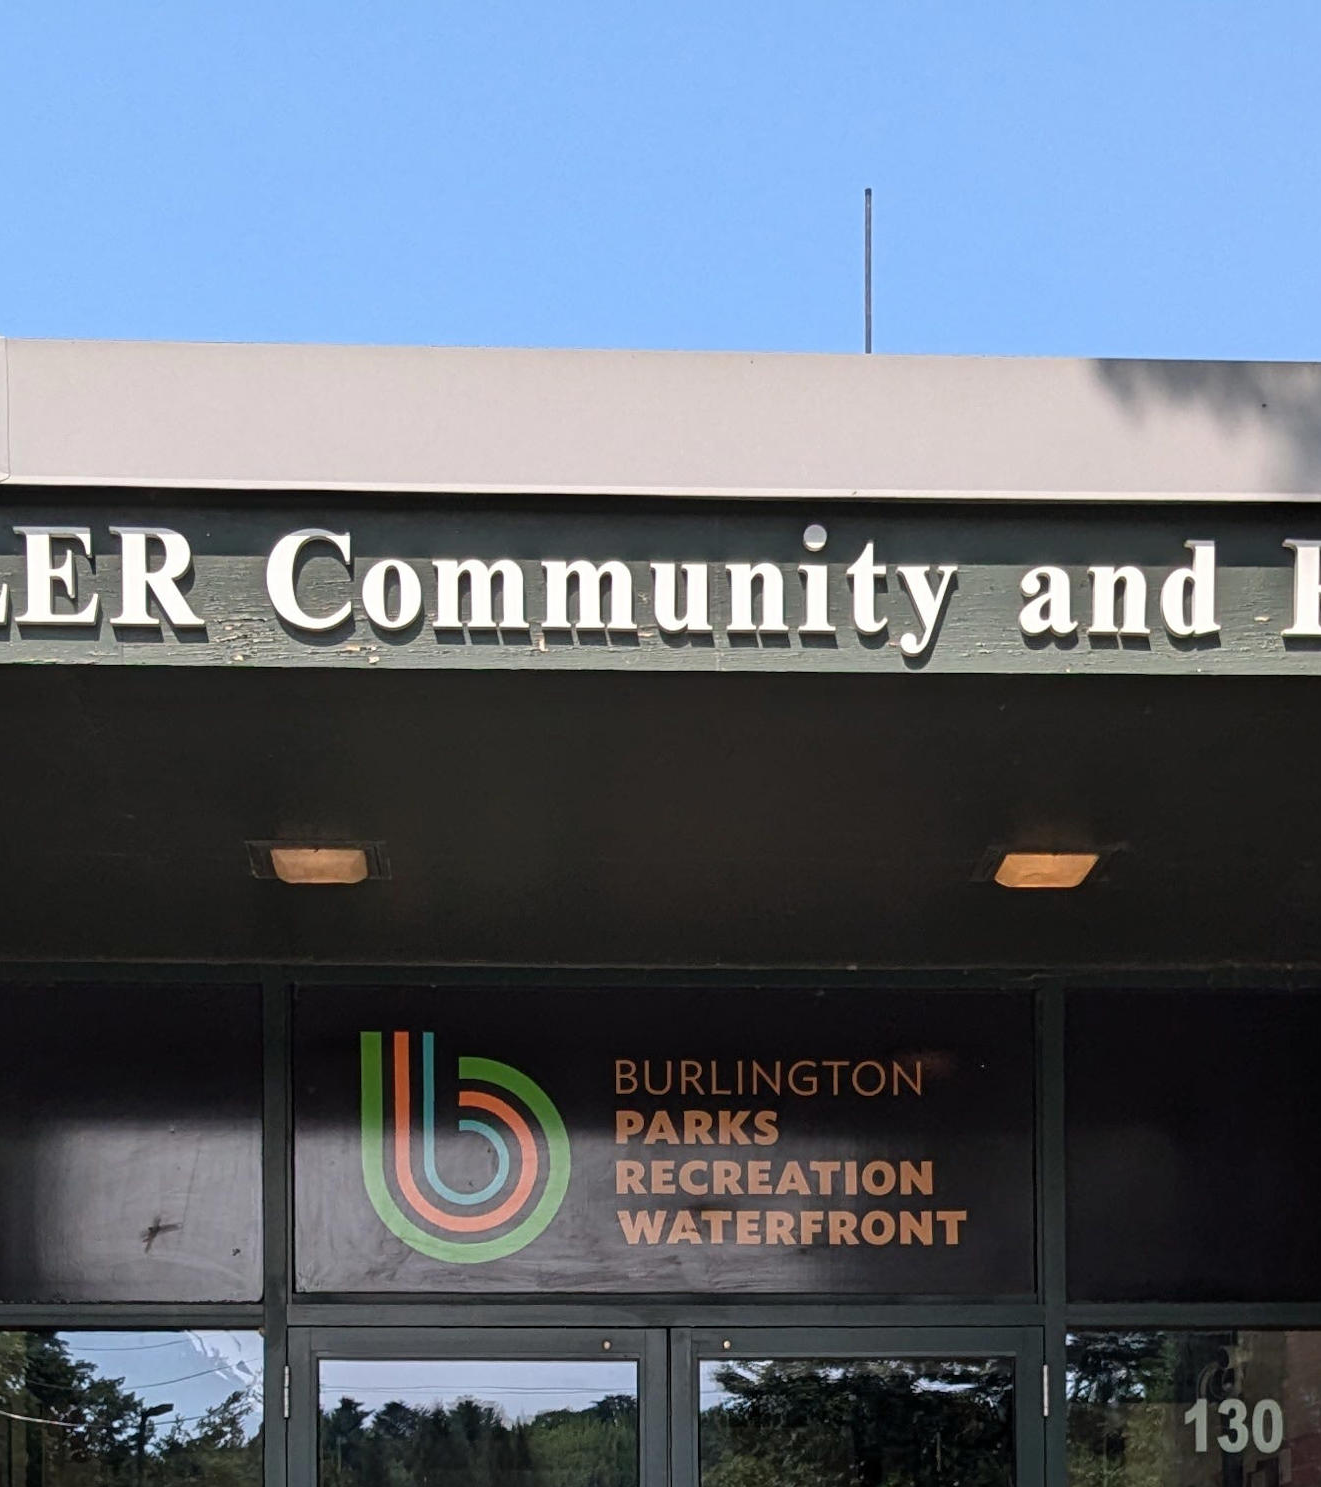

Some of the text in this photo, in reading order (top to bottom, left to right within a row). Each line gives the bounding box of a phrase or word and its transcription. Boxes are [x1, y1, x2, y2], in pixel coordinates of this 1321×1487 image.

[266, 524, 958, 658] Community
[1019, 539, 1221, 640] and
[614, 1059, 924, 1097] BURLINGTON
[615, 1109, 780, 1146] PARKS
[615, 1159, 934, 1196] RECREATION
[616, 1209, 968, 1246] WATERFRONT
[1183, 1397, 1284, 1454] 130
